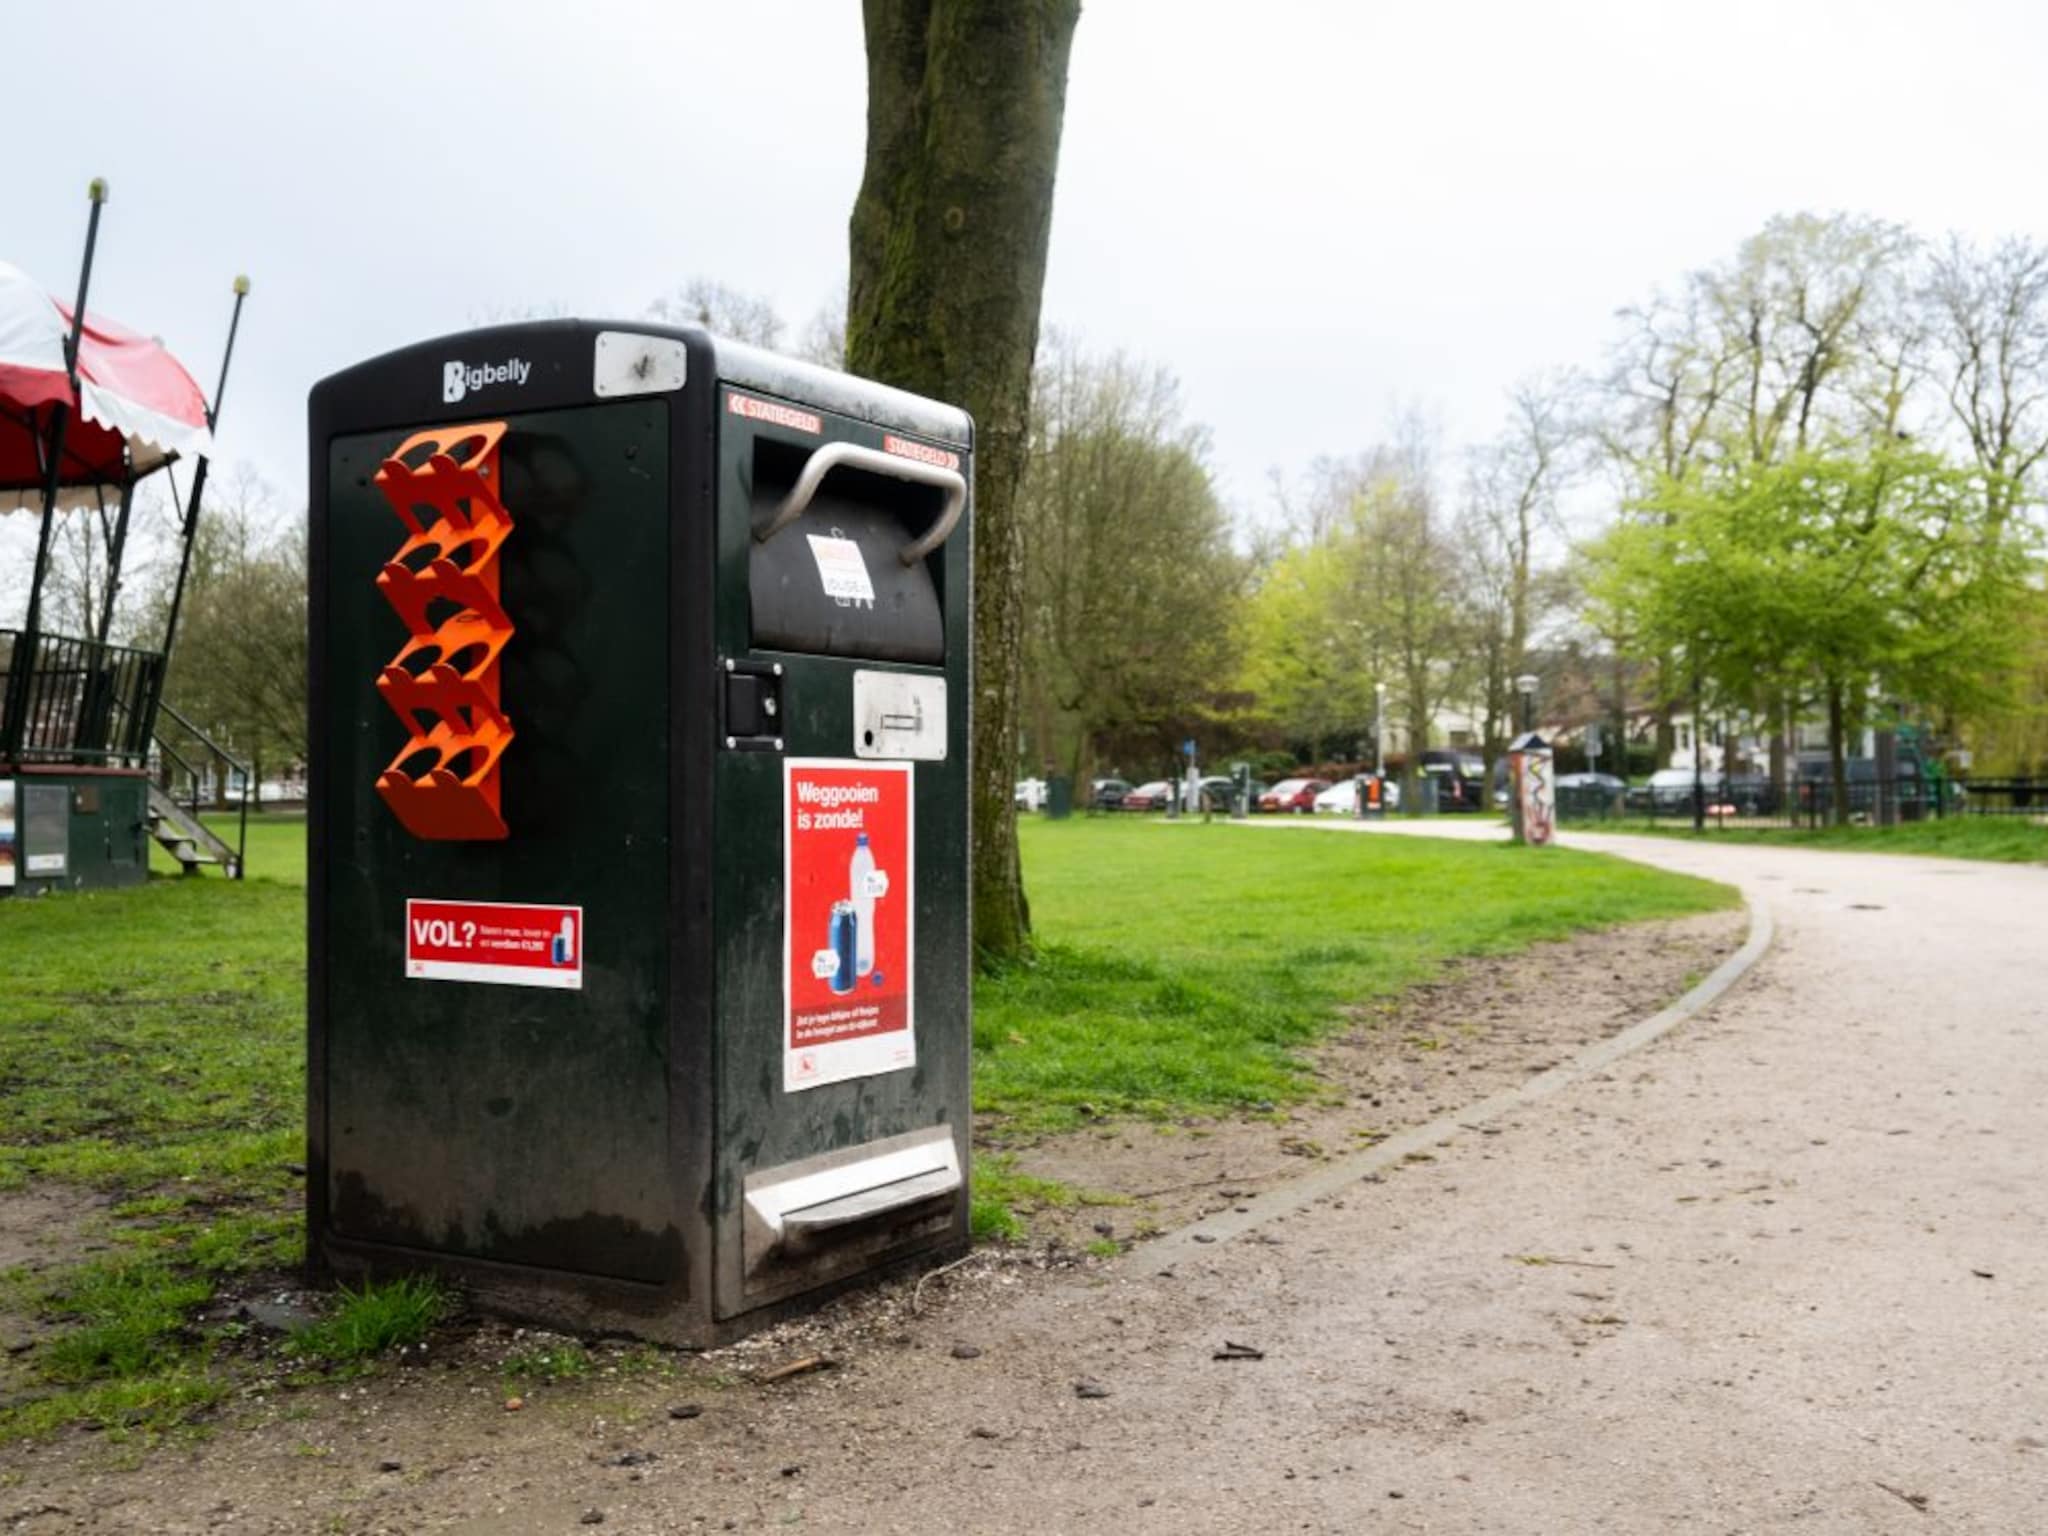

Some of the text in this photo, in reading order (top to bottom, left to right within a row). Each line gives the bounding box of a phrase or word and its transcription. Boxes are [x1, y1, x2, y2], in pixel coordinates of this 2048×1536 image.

[443, 357, 531, 403] Bigbelly
[748, 400, 820, 434] STATIEGELD
[796, 781, 879, 808] Weggooien
[798, 807, 864, 830] is zonde!
[412, 919, 477, 948] VOL?
